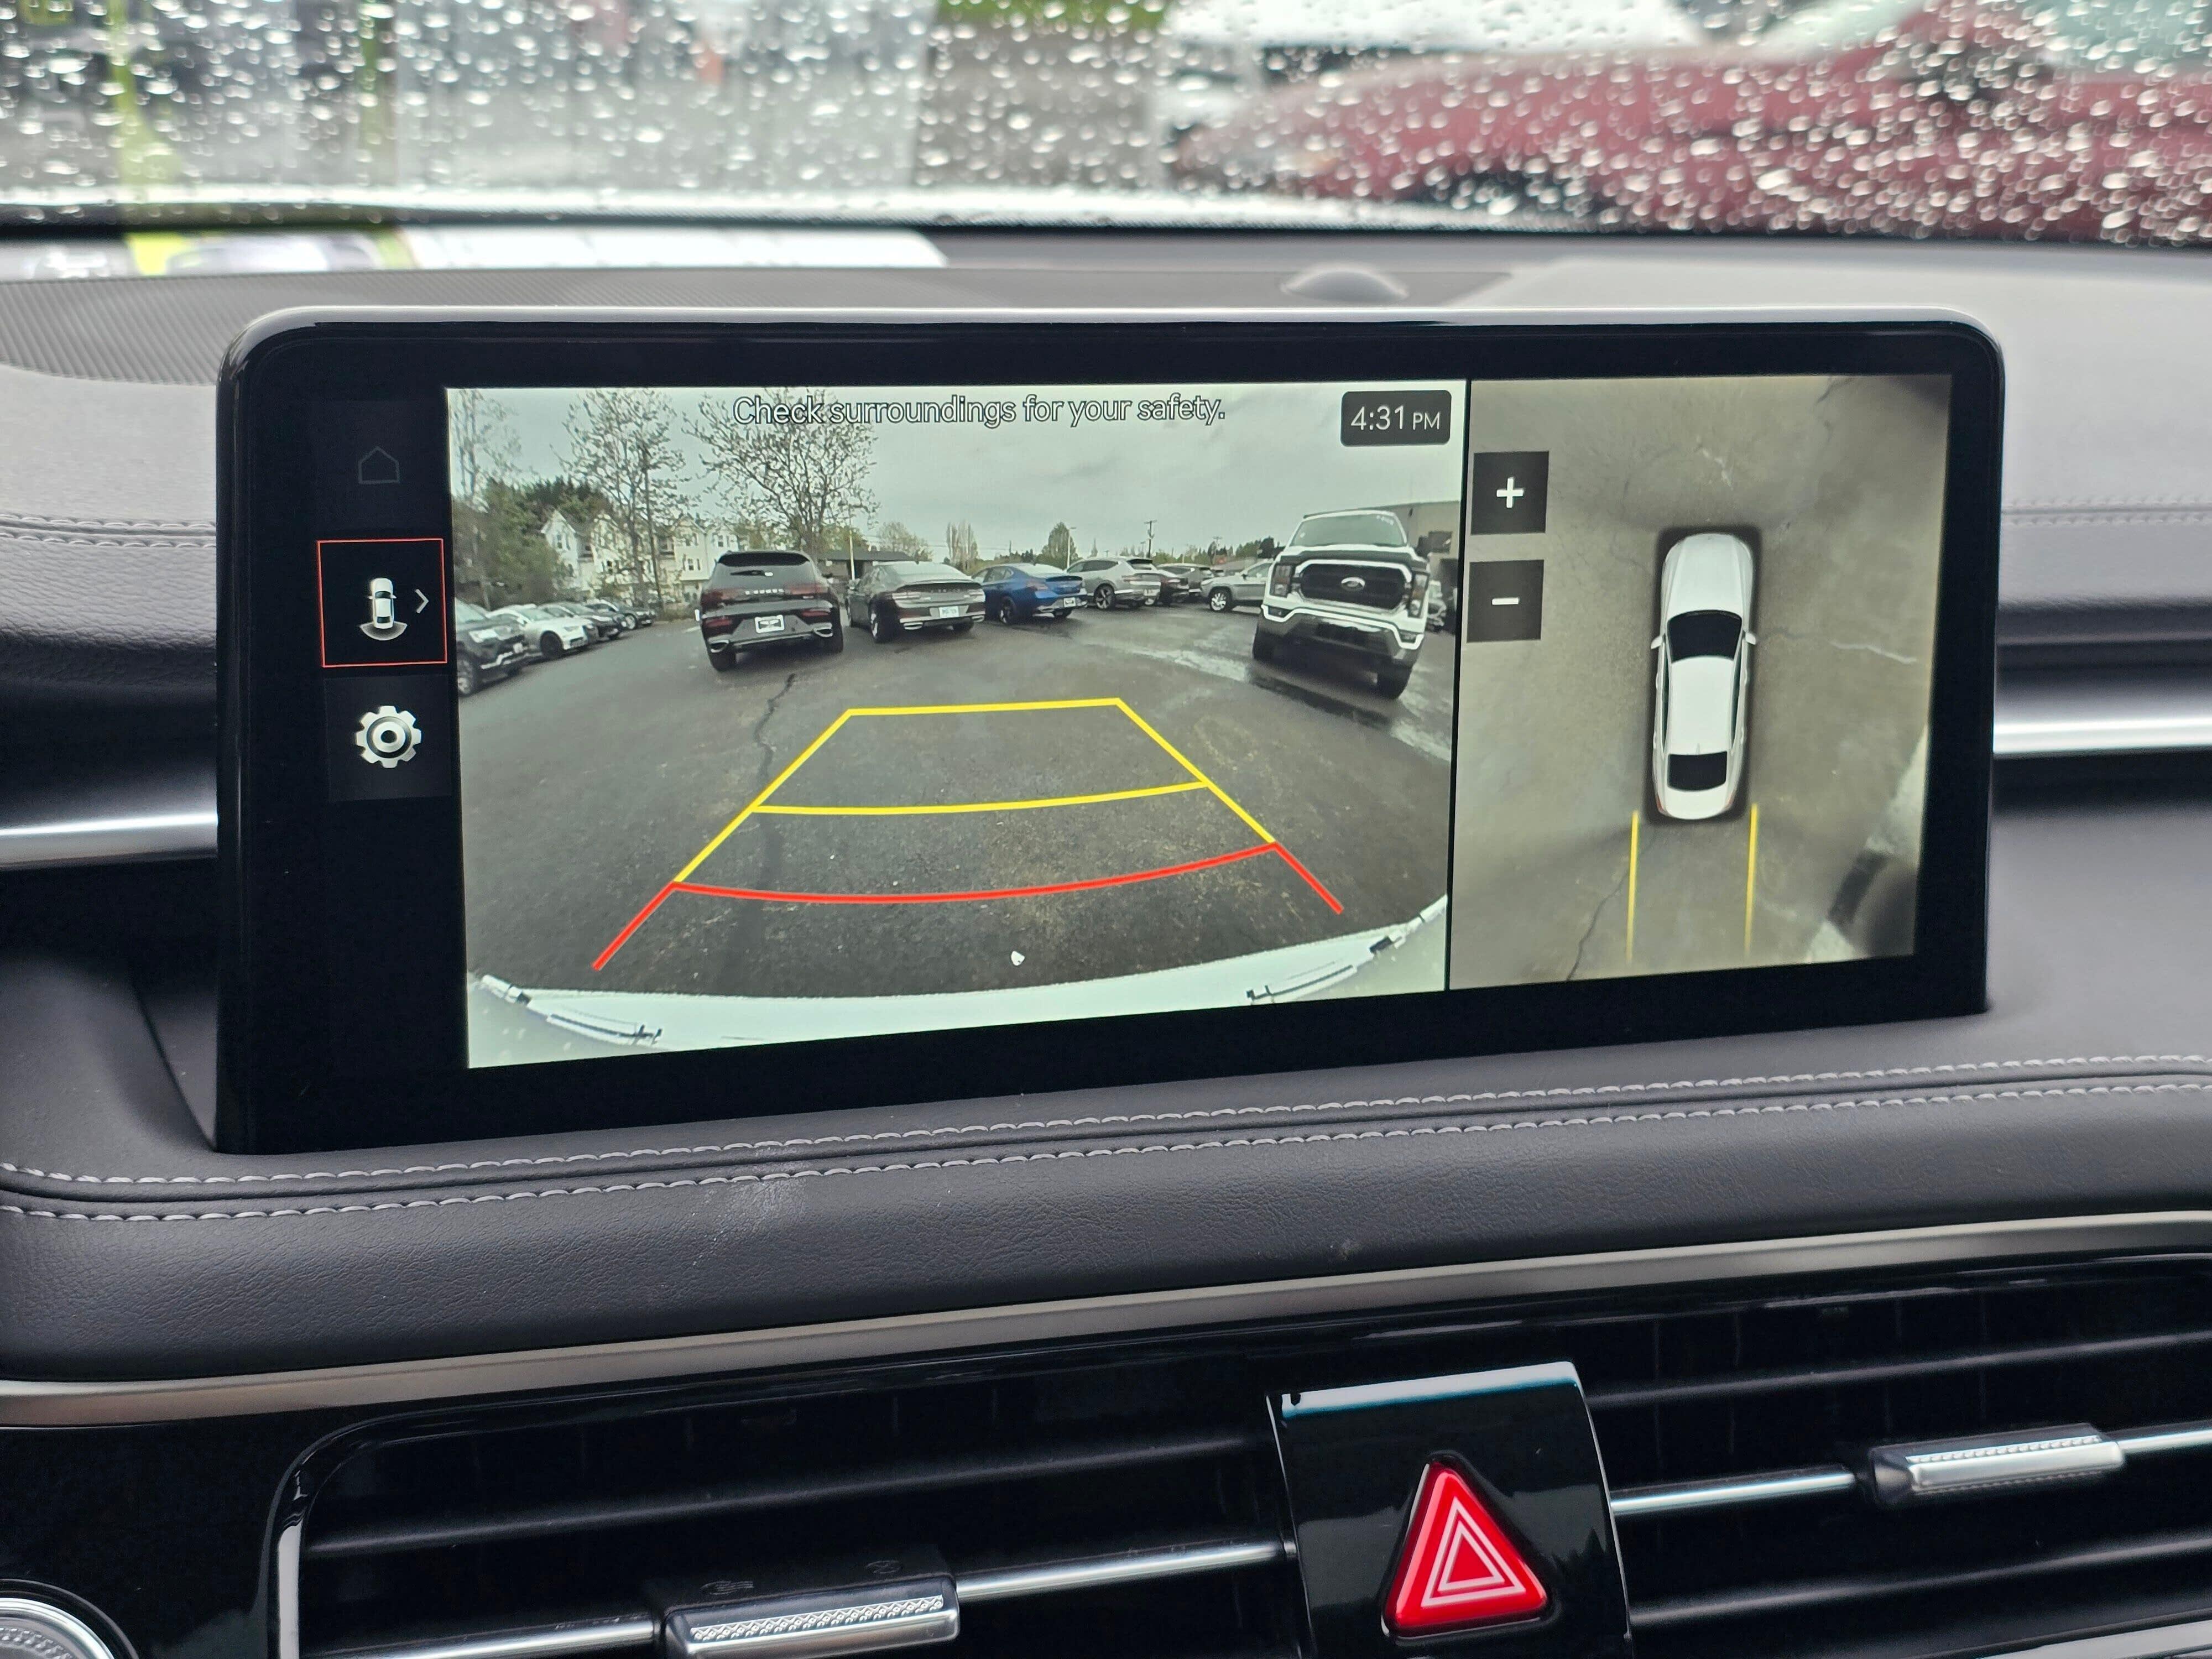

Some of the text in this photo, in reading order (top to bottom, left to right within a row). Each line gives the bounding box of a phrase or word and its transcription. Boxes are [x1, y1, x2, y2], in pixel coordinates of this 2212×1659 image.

[733, 393, 1225, 429] Check surroundings for your safety.
[1350, 405, 1440, 430] 4:31 PM
